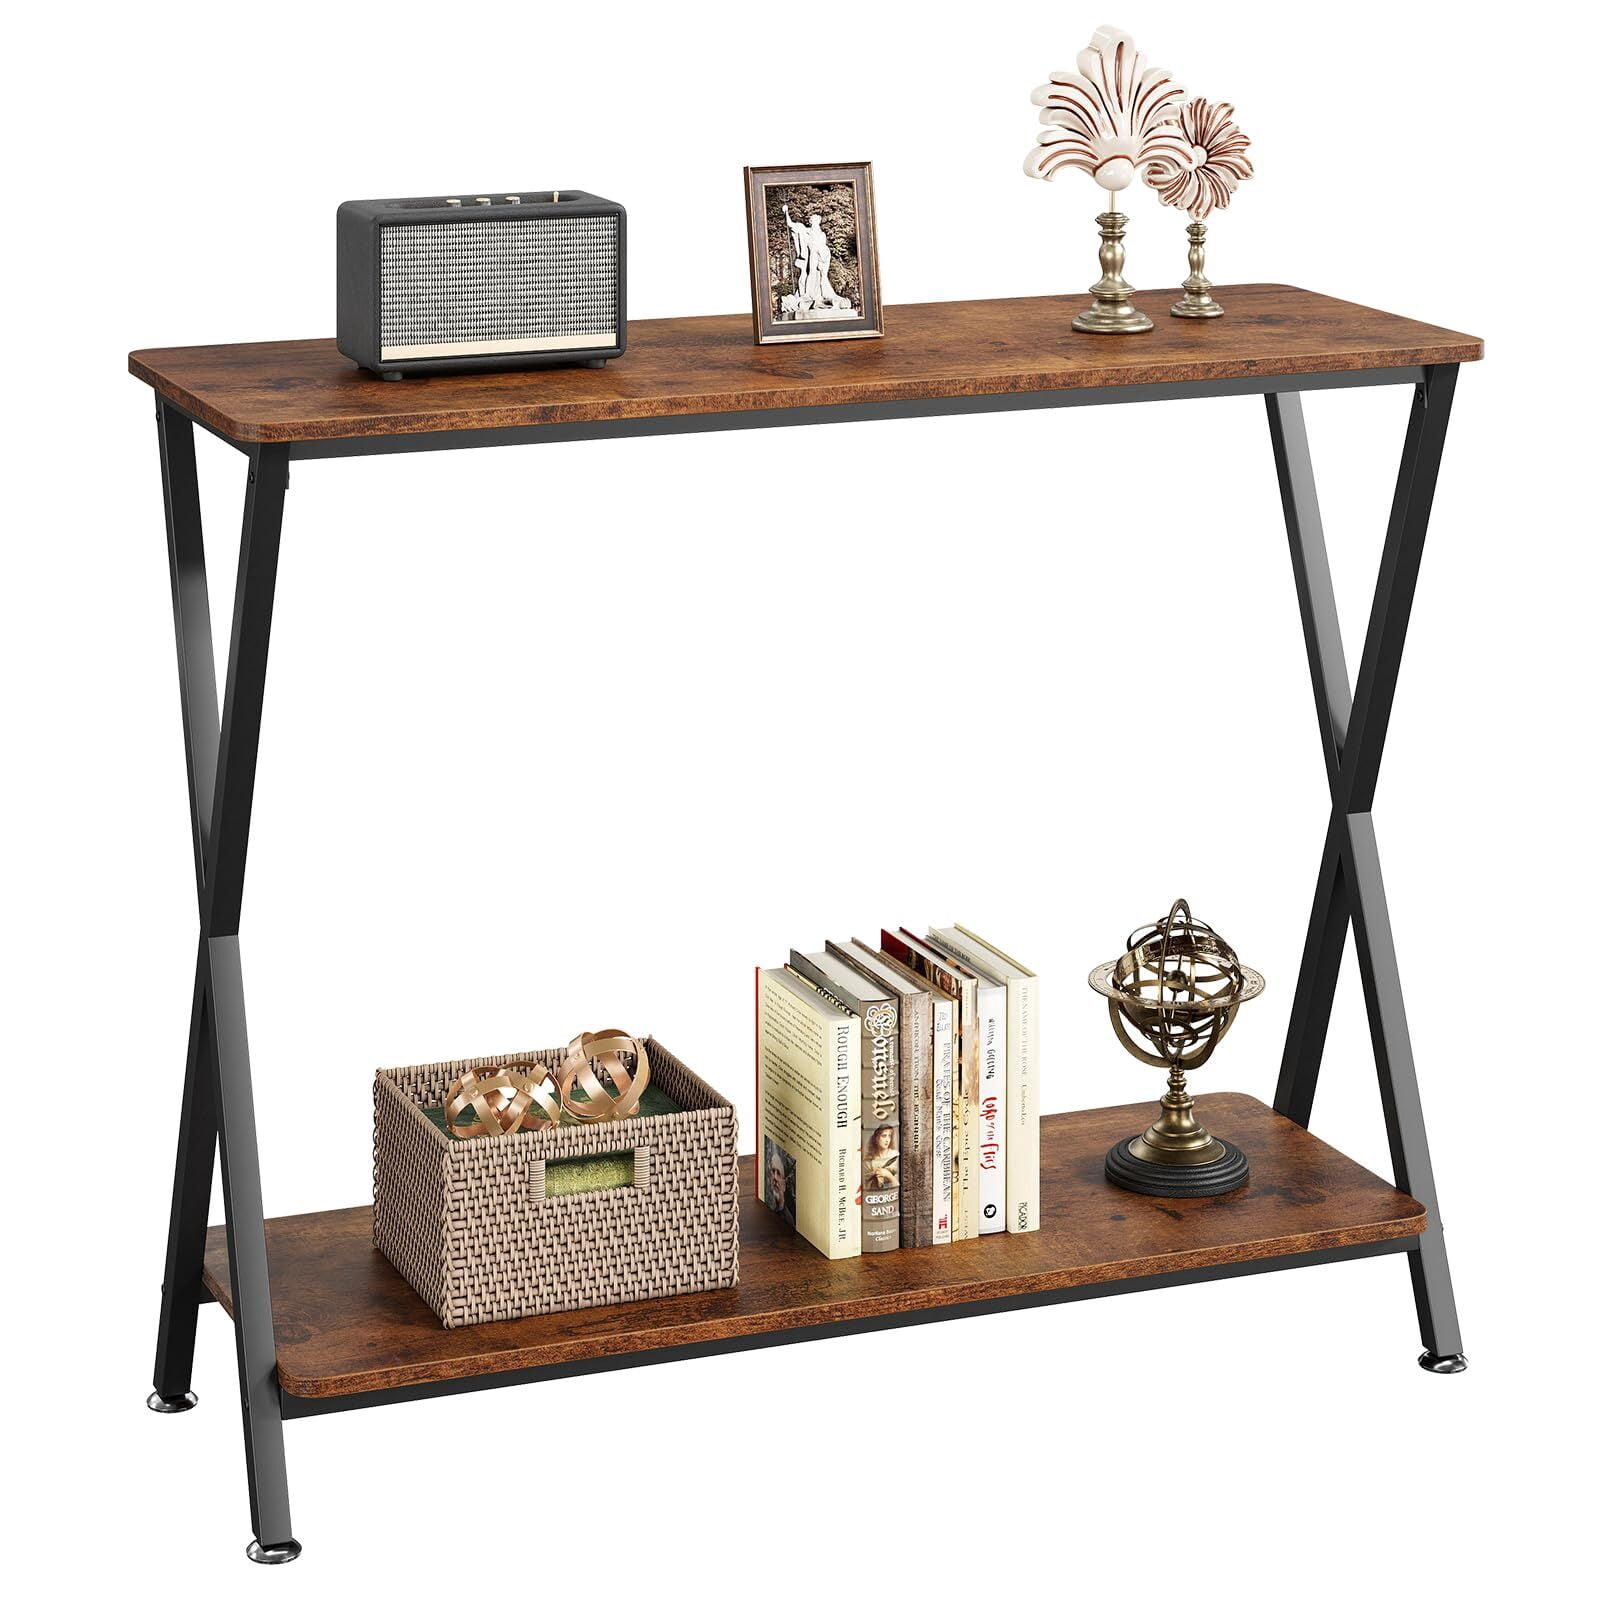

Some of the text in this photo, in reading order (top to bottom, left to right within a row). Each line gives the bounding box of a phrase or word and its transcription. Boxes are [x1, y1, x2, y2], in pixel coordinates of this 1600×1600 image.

[836, 1026, 850, 1129] ROUGH ENOUGH
[864, 1192, 899, 1204] GEORGE
[871, 1205, 895, 1216] SAND
[1018, 1201, 1029, 1231] PICADOR
